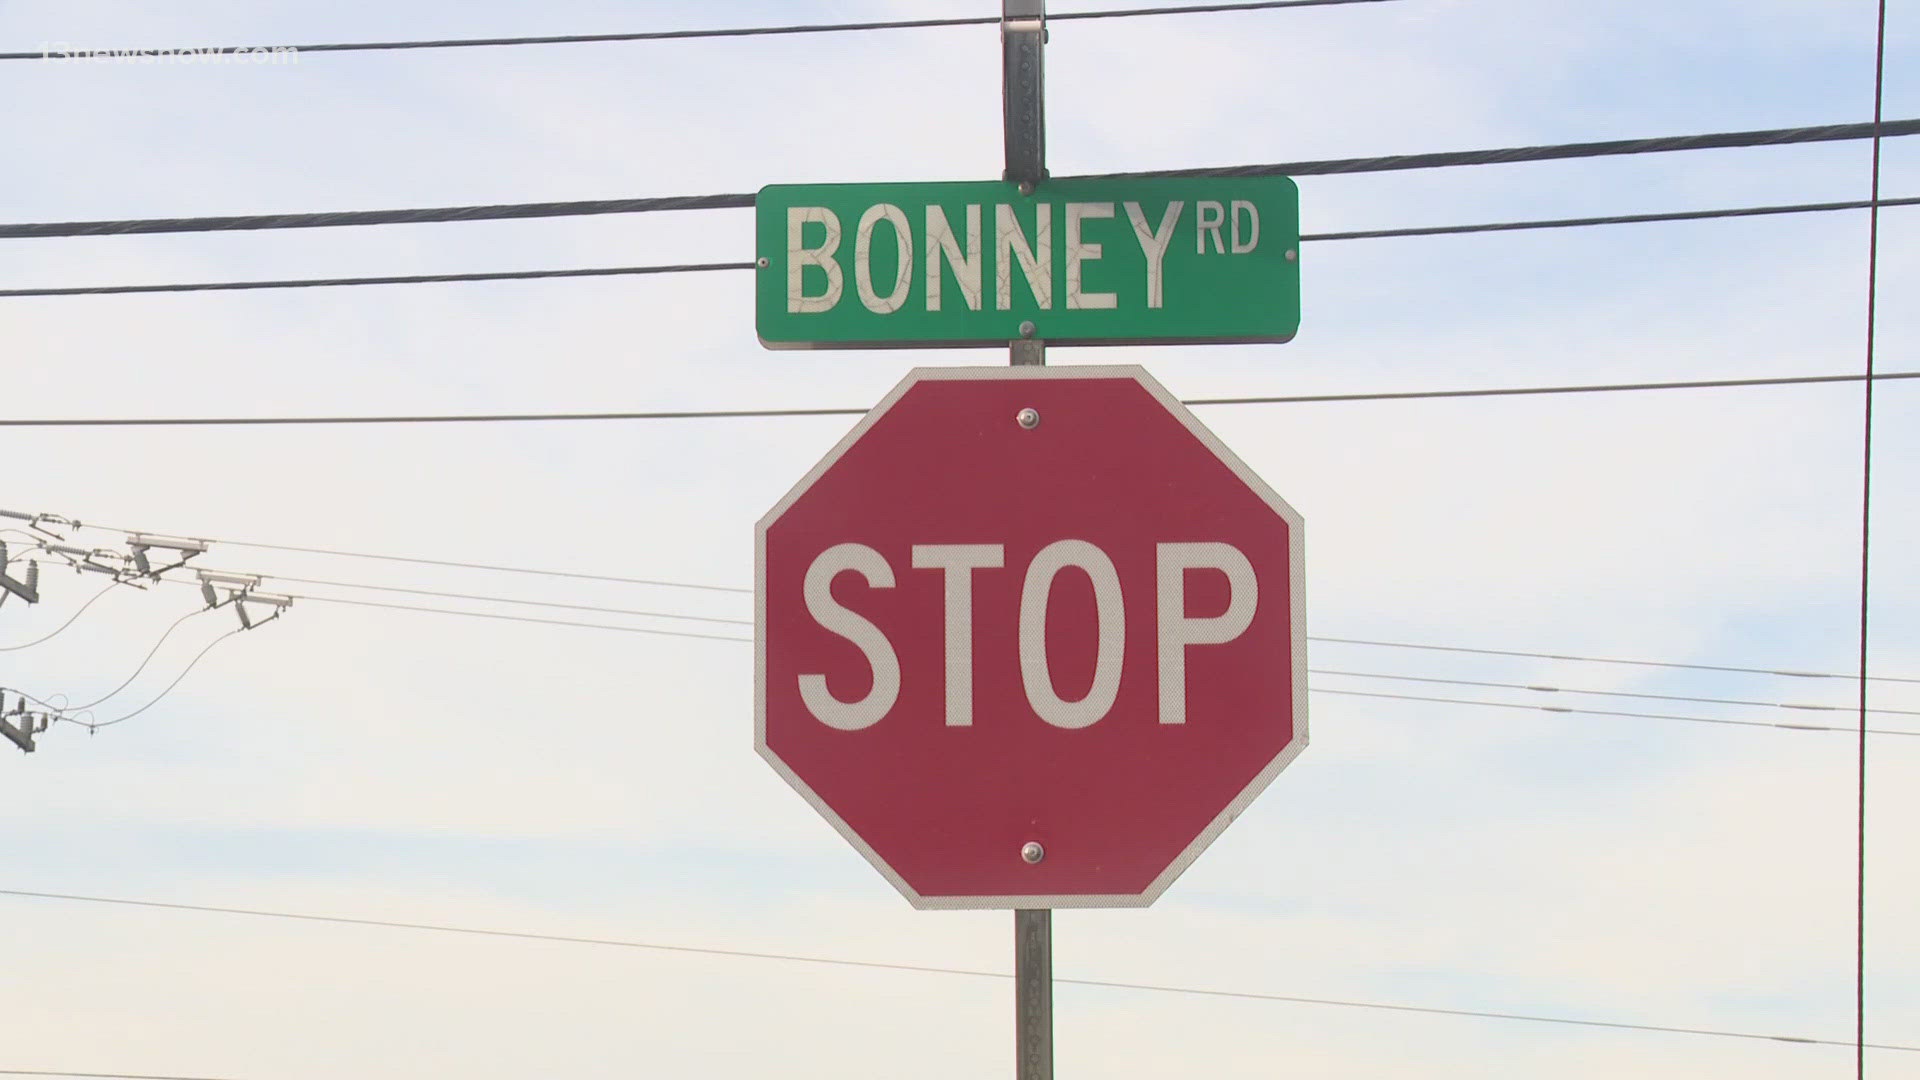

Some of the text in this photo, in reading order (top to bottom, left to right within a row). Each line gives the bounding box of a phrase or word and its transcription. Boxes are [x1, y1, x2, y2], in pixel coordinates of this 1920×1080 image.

[787, 200, 1260, 314] BONNEY RD
[797, 539, 1259, 731] STOP
